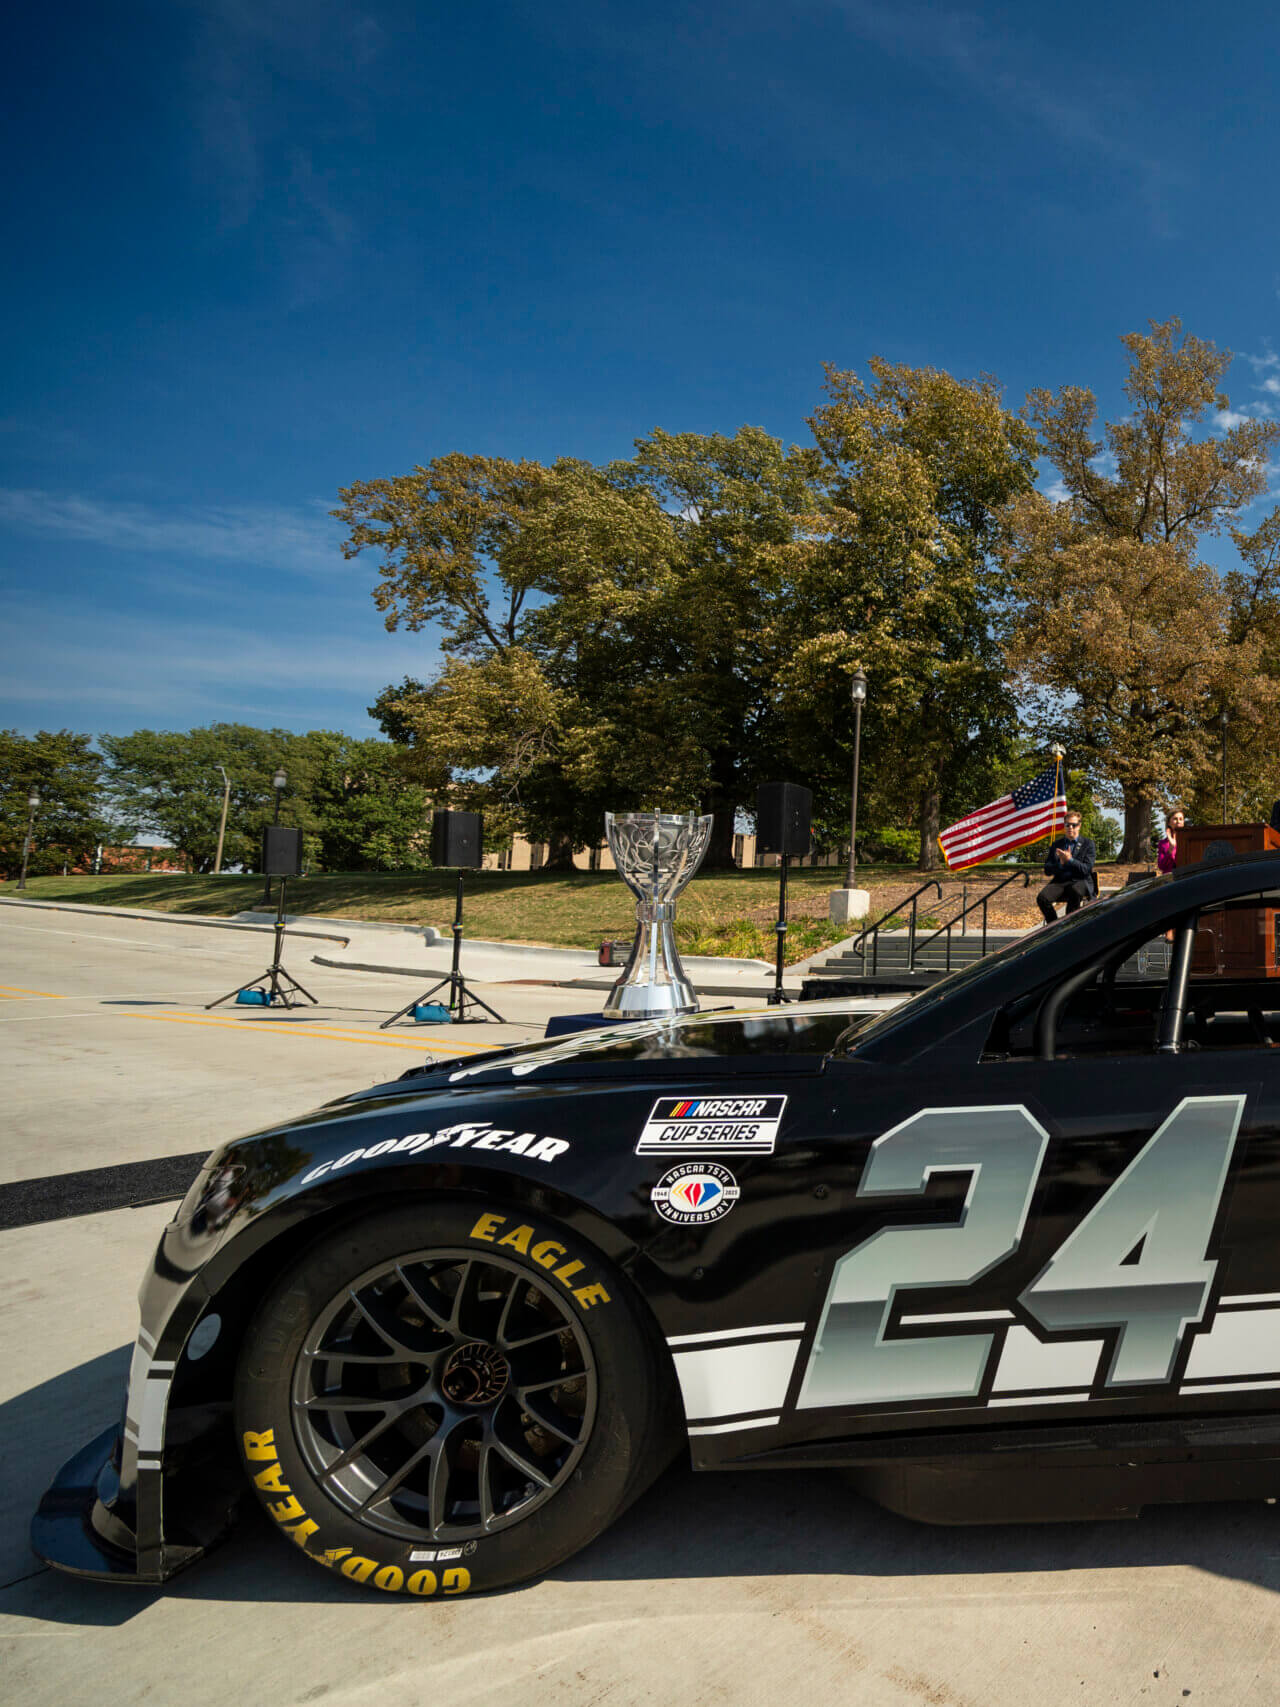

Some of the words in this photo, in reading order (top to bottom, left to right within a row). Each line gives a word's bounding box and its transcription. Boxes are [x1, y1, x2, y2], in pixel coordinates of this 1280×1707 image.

[692, 1099, 767, 1117] NASCAR
[658, 1125, 698, 1142] CUP
[697, 1124, 760, 1141] SERIES
[300, 1121, 570, 1185] GOODYEAR
[665, 1164, 705, 1184] NASCAR
[707, 1164, 730, 1184] 75TH
[659, 1200, 730, 1223] ANNIVERSARY
[469, 1212, 611, 1311] EAGLE
[796, 1094, 1247, 1410] 24
